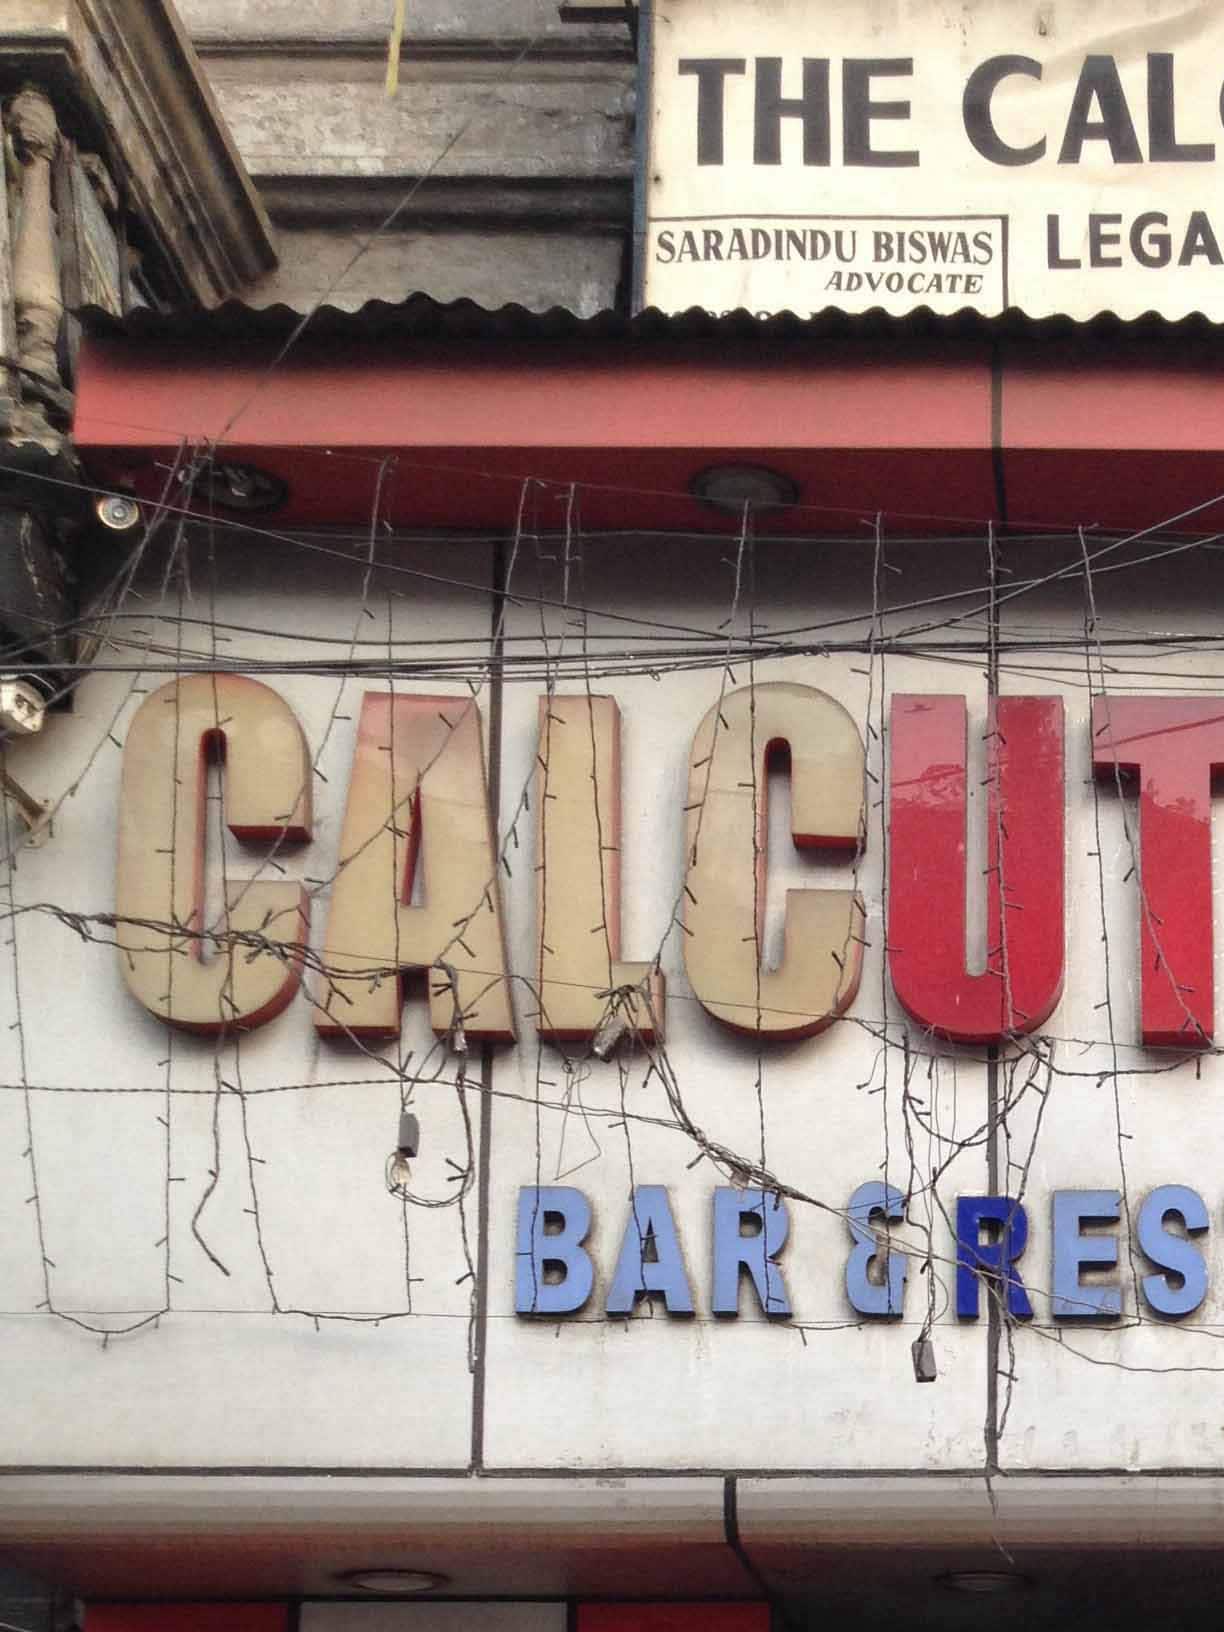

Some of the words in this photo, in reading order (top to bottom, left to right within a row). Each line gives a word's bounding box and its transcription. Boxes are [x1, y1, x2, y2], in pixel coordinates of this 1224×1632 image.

[678, 57, 919, 167] THE
[656, 228, 857, 265] SARADINDU
[872, 230, 993, 265] BISWAS
[824, 270, 984, 295] ADVOCATE
[515, 1184, 794, 1320] BAR
[845, 1180, 908, 1322] &
